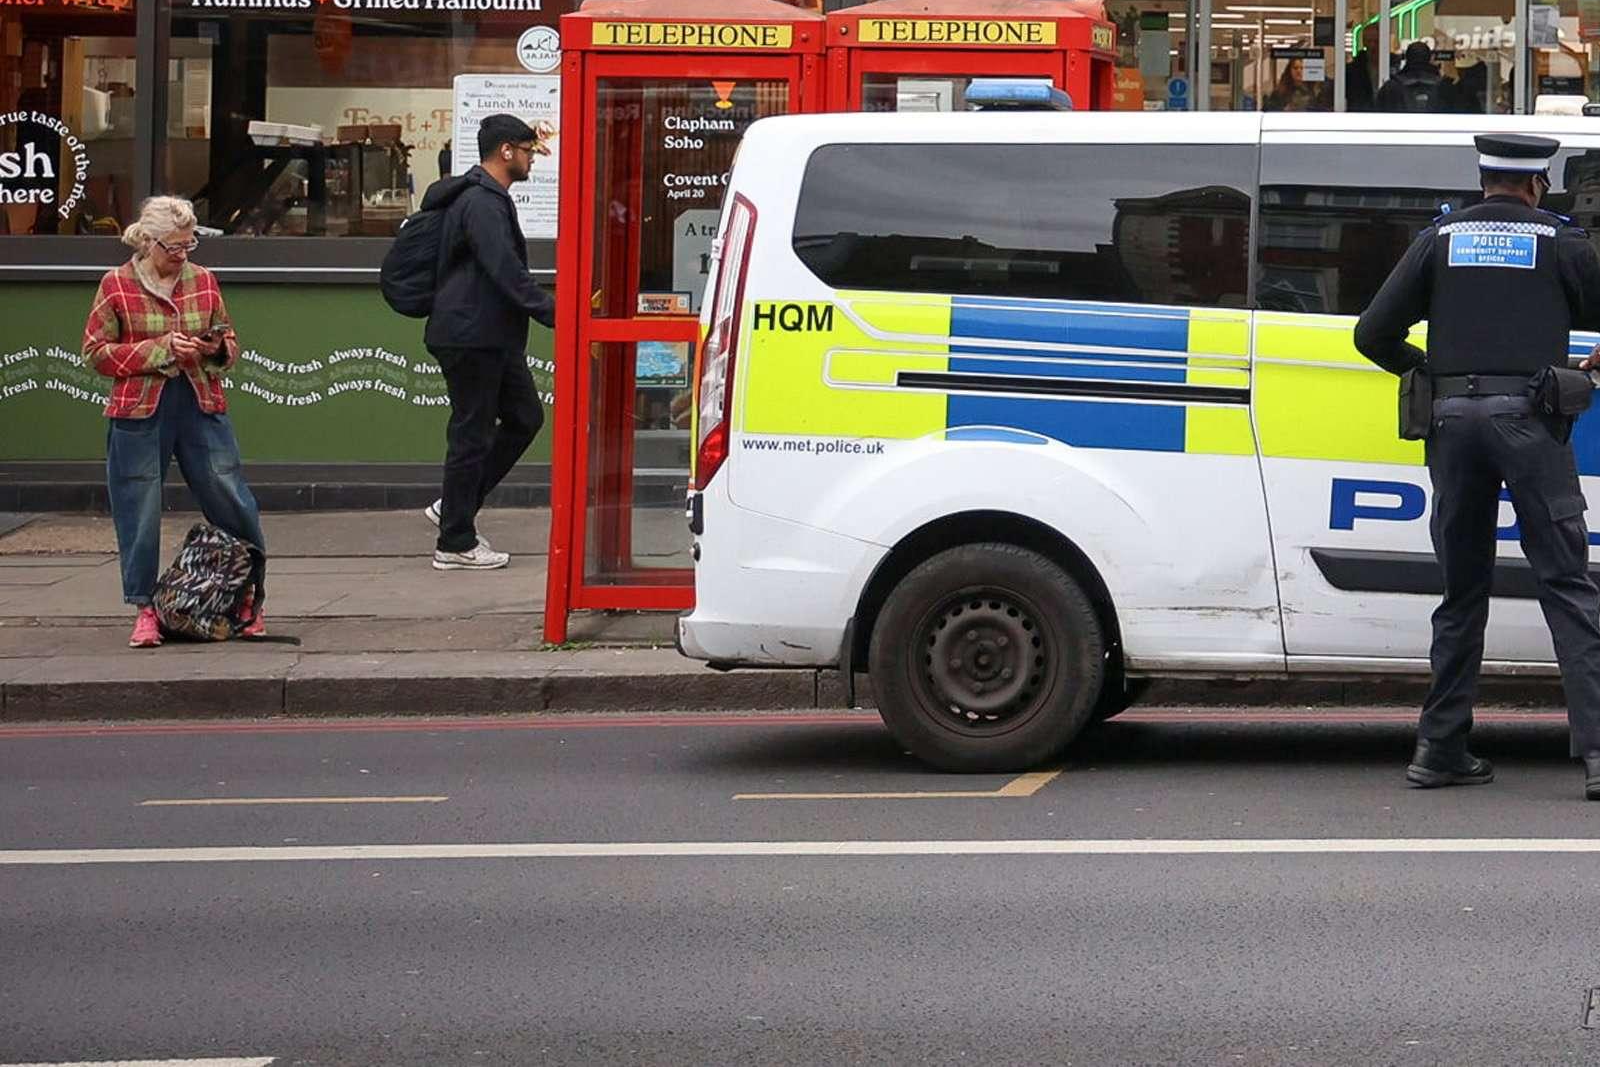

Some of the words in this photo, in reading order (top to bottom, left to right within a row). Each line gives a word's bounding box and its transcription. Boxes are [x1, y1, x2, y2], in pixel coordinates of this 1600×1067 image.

[606, 25, 779, 47] TELEPHONE
[871, 20, 1043, 44] TELEPHONE
[477, 99, 514, 109] Lunch
[518, 100, 551, 109] Menu
[31, 110, 69, 136] taste
[664, 116, 734, 131] Clapham
[66, 135, 86, 152] of
[664, 136, 703, 150] Soho
[74, 153, 90, 181] the
[663, 173, 718, 186] Covent
[58, 183, 85, 219] med
[667, 189, 690, 200] April
[692, 189, 705, 199] 20
[685, 222, 698, 236] A
[1473, 236, 1513, 247] POLICE
[1499, 248, 1528, 256] SUPPORT
[753, 304, 834, 332] HQM
[3, 346, 39, 366] fresh
[46, 345, 88, 368] alway
[241, 349, 285, 373] always
[287, 358, 323, 375] fresh
[328, 347, 373, 365] always
[374, 347, 408, 368] fresh
[3, 378, 38, 397] fresh
[45, 378, 90, 403] always
[91, 391, 110, 406] fre
[240, 381, 285, 405] always
[286, 390, 322, 406] fresh
[327, 379, 373, 397] always
[373, 379, 407, 400] fresh
[412, 392, 450, 406] alway
[742, 438, 885, 455] www.met.police.uk
